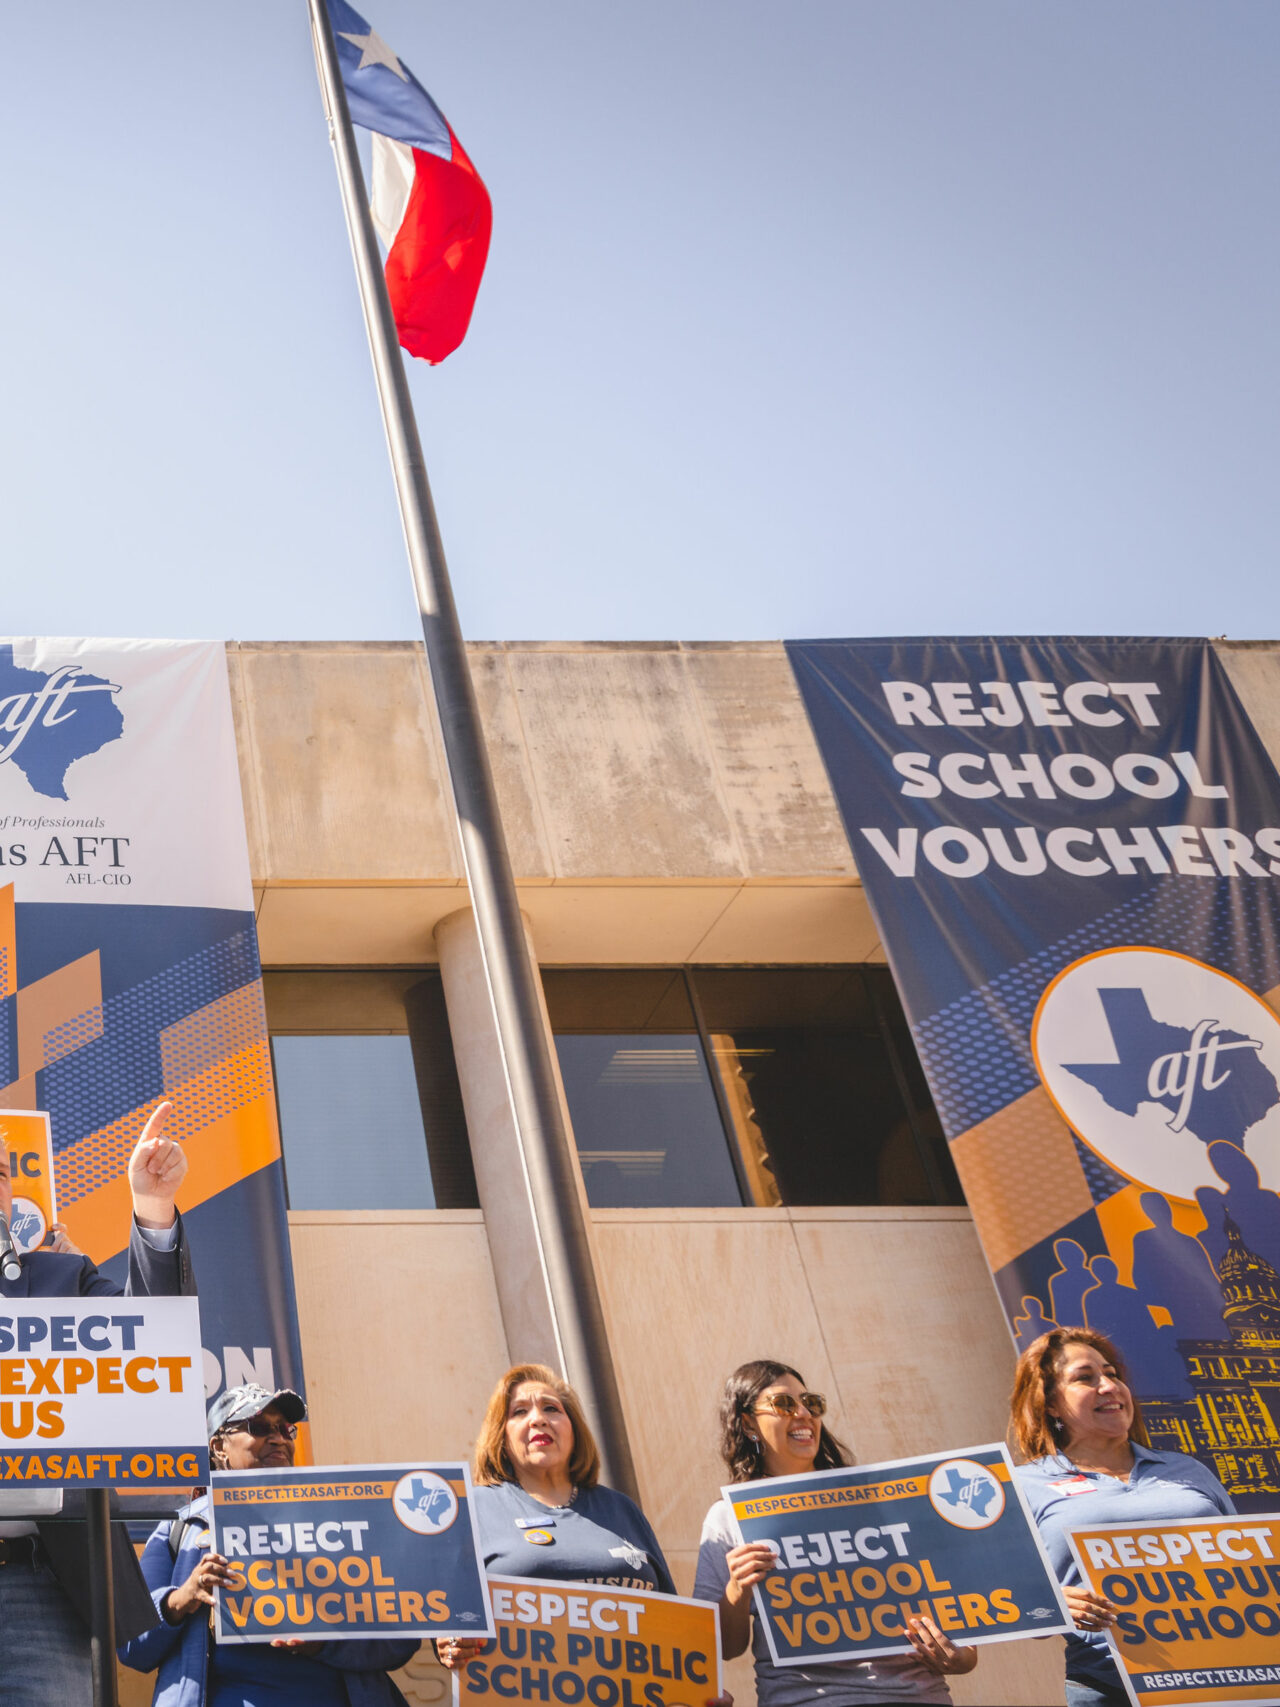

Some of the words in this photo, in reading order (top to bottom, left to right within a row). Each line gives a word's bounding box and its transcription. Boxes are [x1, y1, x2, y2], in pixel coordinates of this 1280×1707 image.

[881, 681, 1161, 727] REJECT
[892, 751, 1229, 800] SCHOOL
[12, 816, 105, 830] Professionals
[39, 836, 130, 867] AFT
[65, 873, 132, 886] AFL-CIO
[1147, 1019, 1263, 1133] aft
[0, 1356, 192, 1395] EXPECT
[0, 1400, 65, 1440] US
[223, 1484, 384, 1501] RESPECT.TEXASAFT.ORG
[745, 1481, 918, 1514] RESPECT.TEXASAFT.ORG
[222, 1520, 369, 1557] REJECT
[752, 1522, 910, 1570] REJECT
[1082, 1527, 1275, 1570] RESPECT
[226, 1556, 395, 1592] SCHOOL
[765, 1559, 951, 1609] SCHOOL
[1101, 1570, 1207, 1606] OUR
[225, 1590, 451, 1627] VOUCHERS
[491, 1588, 645, 1635] ESPECT
[773, 1588, 1020, 1647] VOUCHERS
[567, 1633, 709, 1685] PUBLIC
[466, 1660, 665, 1707] SCHOOLS
